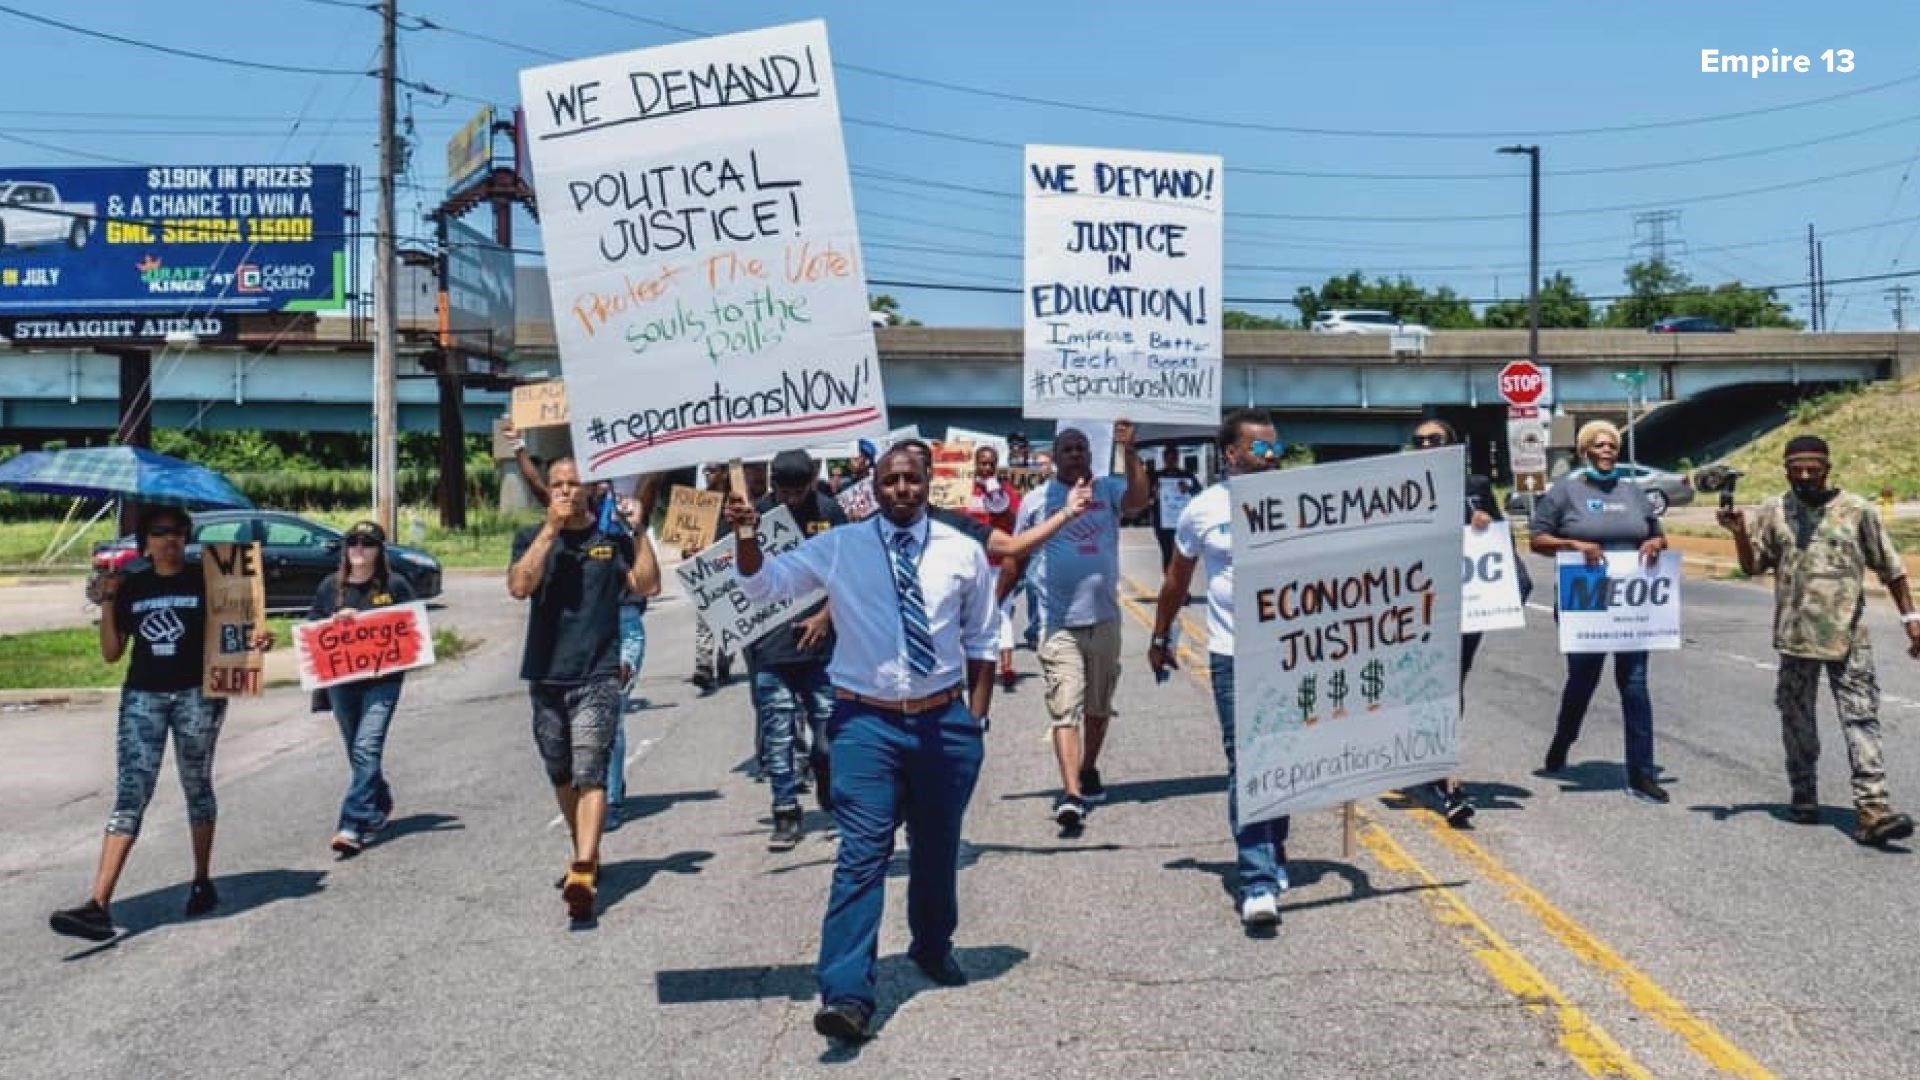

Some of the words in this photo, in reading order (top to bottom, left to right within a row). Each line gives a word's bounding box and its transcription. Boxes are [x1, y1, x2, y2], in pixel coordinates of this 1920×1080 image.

[546, 81, 602, 126] WE
[629, 45, 818, 114] DEMAND!
[218, 168, 238, 188] IN
[242, 168, 313, 188] PRIZES
[568, 149, 802, 212] POLITICAL
[1031, 163, 1079, 193] WE
[1094, 163, 1215, 200] DEMAND!
[107, 195, 125, 217] &
[130, 195, 144, 217] A
[149, 194, 223, 217] CHANCE
[228, 194, 251, 216] TO
[257, 193, 295, 216] WIN
[300, 193, 313, 215] A
[162, 218, 242, 242] SIERRA
[600, 192, 802, 262] JUSTICE!
[1067, 221, 1188, 257] JUSTICE
[262, 264, 315, 277] CASINO
[702, 250, 768, 289] The
[1107, 252, 1131, 275] IN
[705, 295, 744, 326] to
[745, 285, 812, 322] the
[1032, 282, 1208, 326] EDUCATION!
[15, 320, 135, 338] STRAIGHT
[141, 318, 222, 336] AHEAD
[1056, 347, 1118, 370] Tech
[586, 357, 870, 446] #reparationsNOW!
[1503, 373, 1541, 393] STOP
[1242, 496, 1287, 534] WE
[1297, 469, 1438, 529] DEMAND!
[206, 543, 257, 576] WE
[1256, 560, 1433, 623] ECONOMIC
[1568, 576, 1671, 609] MEOC
[318, 620, 409, 650] George
[1279, 592, 1435, 672] JUSTICE!
[328, 639, 402, 677] Floyd
[1359, 658, 1385, 704] $
